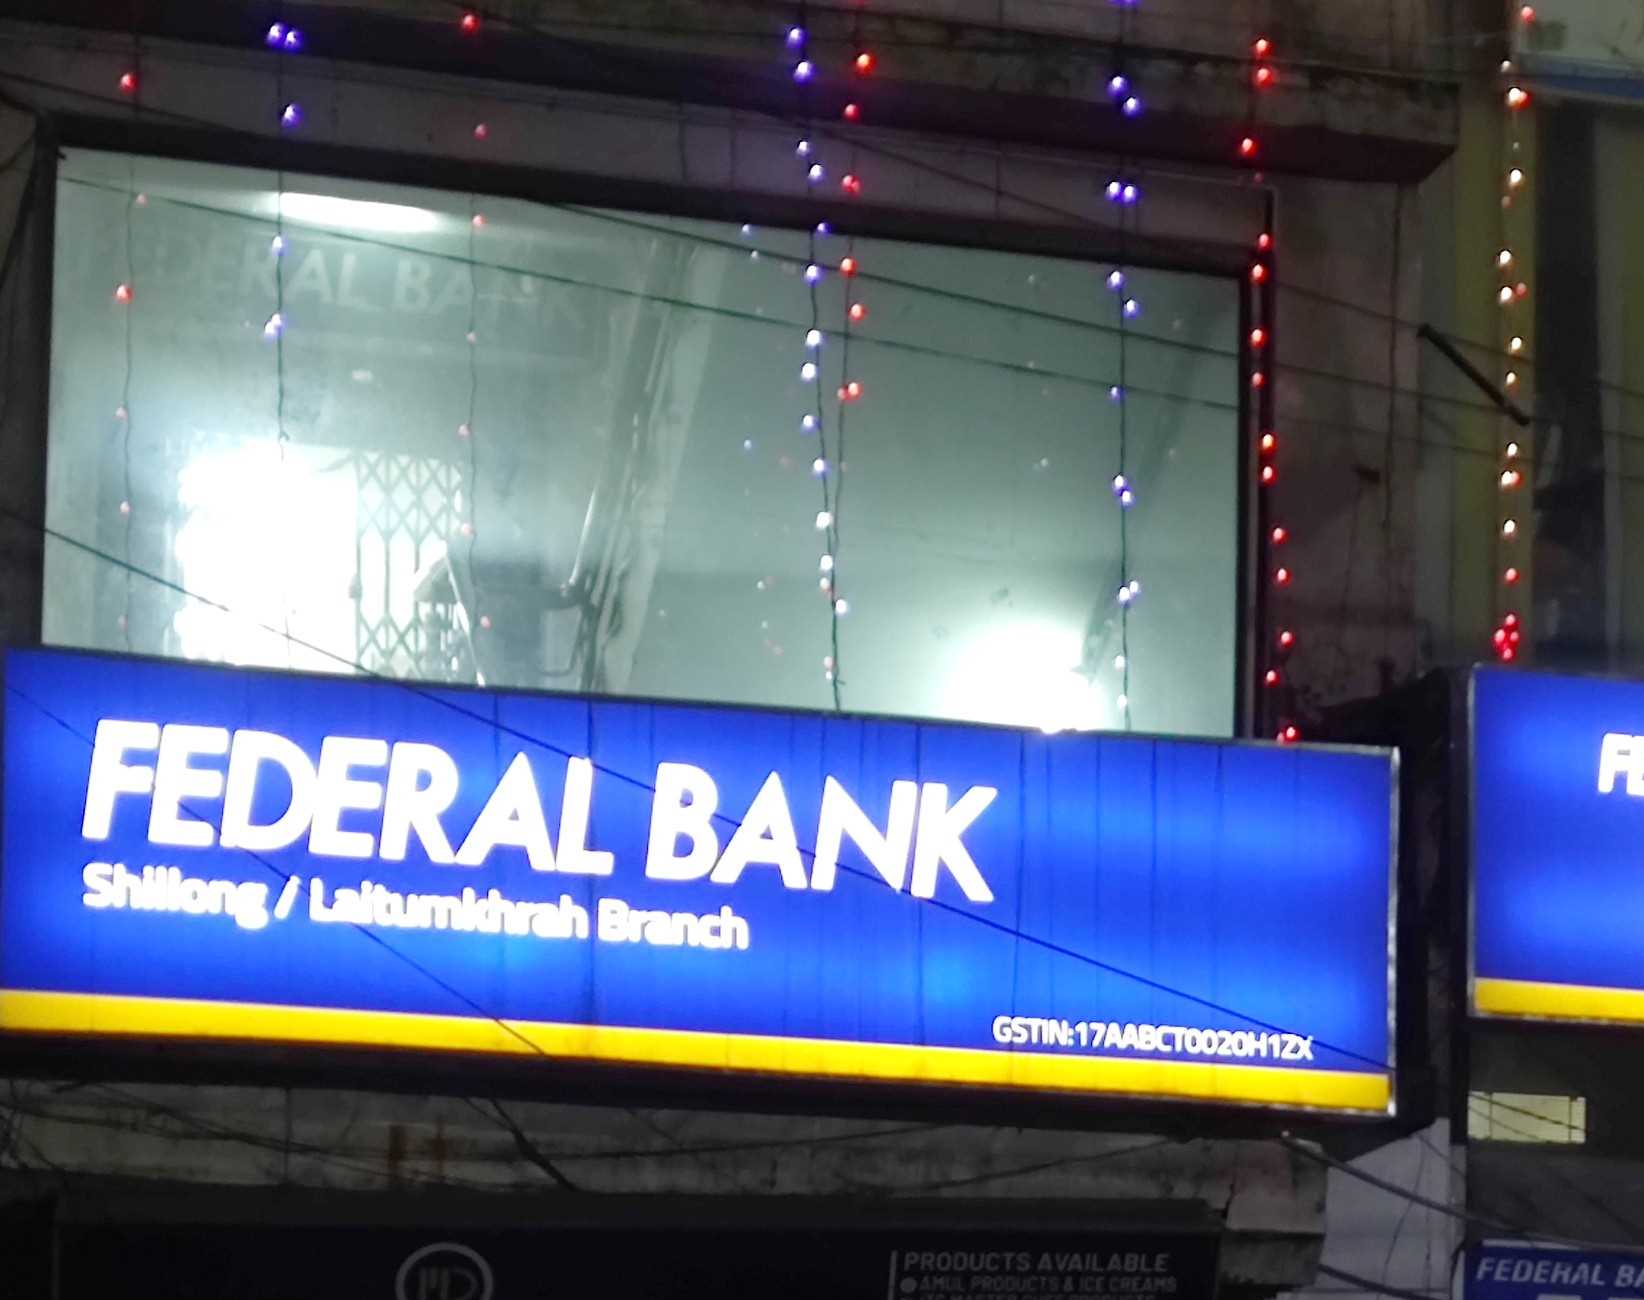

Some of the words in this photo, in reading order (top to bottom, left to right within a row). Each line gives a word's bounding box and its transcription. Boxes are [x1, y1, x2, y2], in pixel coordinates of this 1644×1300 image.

[82, 718, 615, 876] FEDERAL
[645, 761, 998, 902] BANK
[82, 862, 268, 930] Shillong
[273, 877, 300, 920] /
[309, 878, 589, 942] Laitumkhrah
[597, 896, 750, 951] Branch
[903, 1250, 1032, 1273] PRODUCTS
[1037, 1251, 1170, 1274] AVAILABLE
[1476, 1256, 1607, 1287] FEDERAL
[969, 1276, 1061, 1293] PRODUCTS
